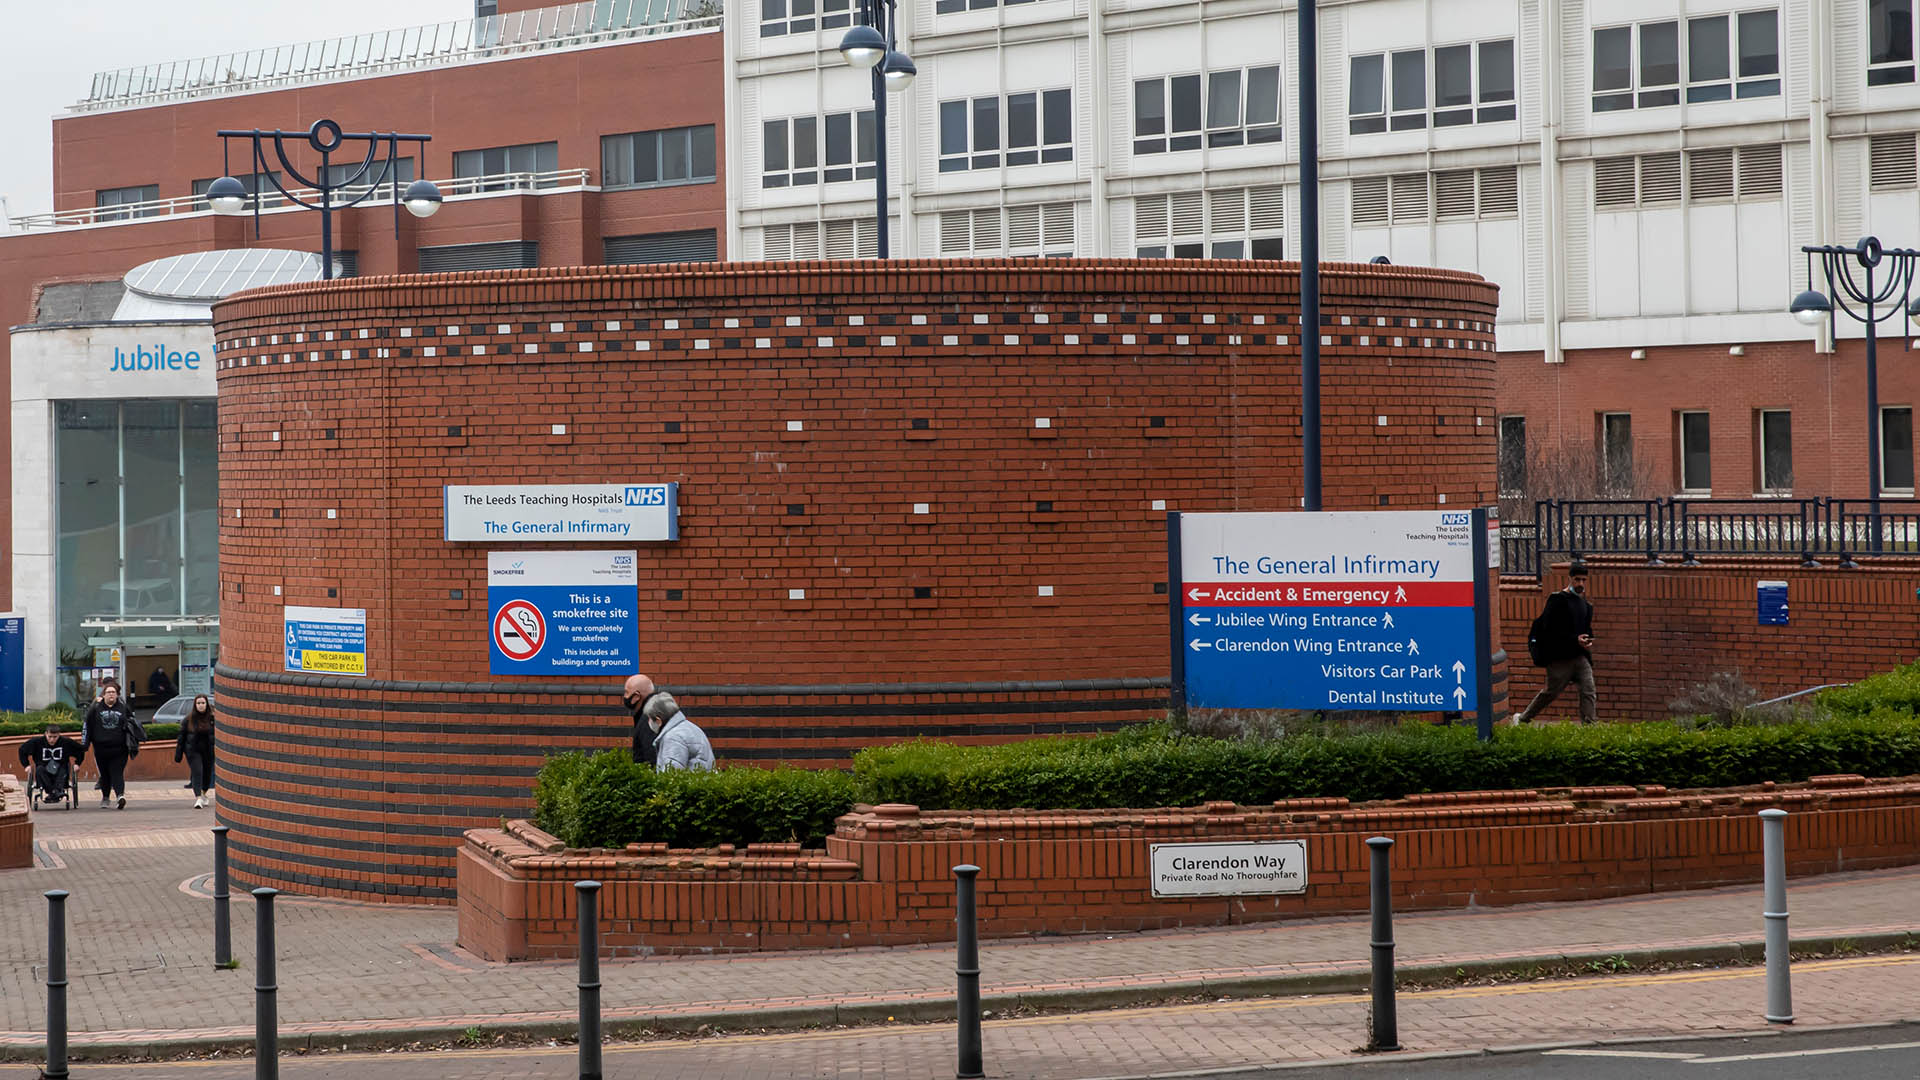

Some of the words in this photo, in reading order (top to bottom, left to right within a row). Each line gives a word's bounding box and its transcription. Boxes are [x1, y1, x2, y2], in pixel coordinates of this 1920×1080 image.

[110, 344, 200, 372] Jubilee
[464, 494, 483, 505] The
[486, 494, 516, 505] Leeds
[520, 494, 568, 506] Teaching
[572, 493, 622, 506] Hospitals
[626, 488, 664, 506] NHS
[1443, 514, 1468, 524] NHS
[484, 521, 508, 534] The
[512, 520, 563, 534] General
[568, 520, 630, 536] Infirmary
[1213, 556, 1250, 574] The
[1257, 556, 1335, 574] General
[1344, 554, 1440, 578] Infirmary
[569, 594, 590, 604] This
[593, 594, 601, 604] is
[604, 596, 611, 604] a
[1214, 588, 1282, 601] Accident
[1286, 588, 1298, 600] &
[1303, 588, 1390, 604] Emergency
[552, 608, 606, 618] smokefree
[610, 608, 628, 618] site
[1215, 613, 1264, 626] Jubilee
[1269, 613, 1307, 629] Wing
[1312, 614, 1377, 626] Entrance
[584, 625, 623, 633] completely
[1215, 638, 1290, 652] Clarendon
[1294, 638, 1332, 655] Wing
[1338, 639, 1403, 653] Entrance
[552, 658, 584, 667] buildings
[601, 658, 630, 667] grounds
[1321, 664, 1376, 678] Visitors
[1380, 665, 1404, 678] Car
[1410, 665, 1442, 678] Park
[1328, 690, 1376, 704] Dental
[1382, 690, 1444, 704] Institute
[1172, 856, 1249, 870] Clarendon
[1254, 856, 1286, 870] Way
[1162, 873, 1192, 882] Private
[1195, 872, 1218, 881] Road
[1221, 872, 1234, 880] No
[1236, 870, 1298, 881] Thoroughfare
